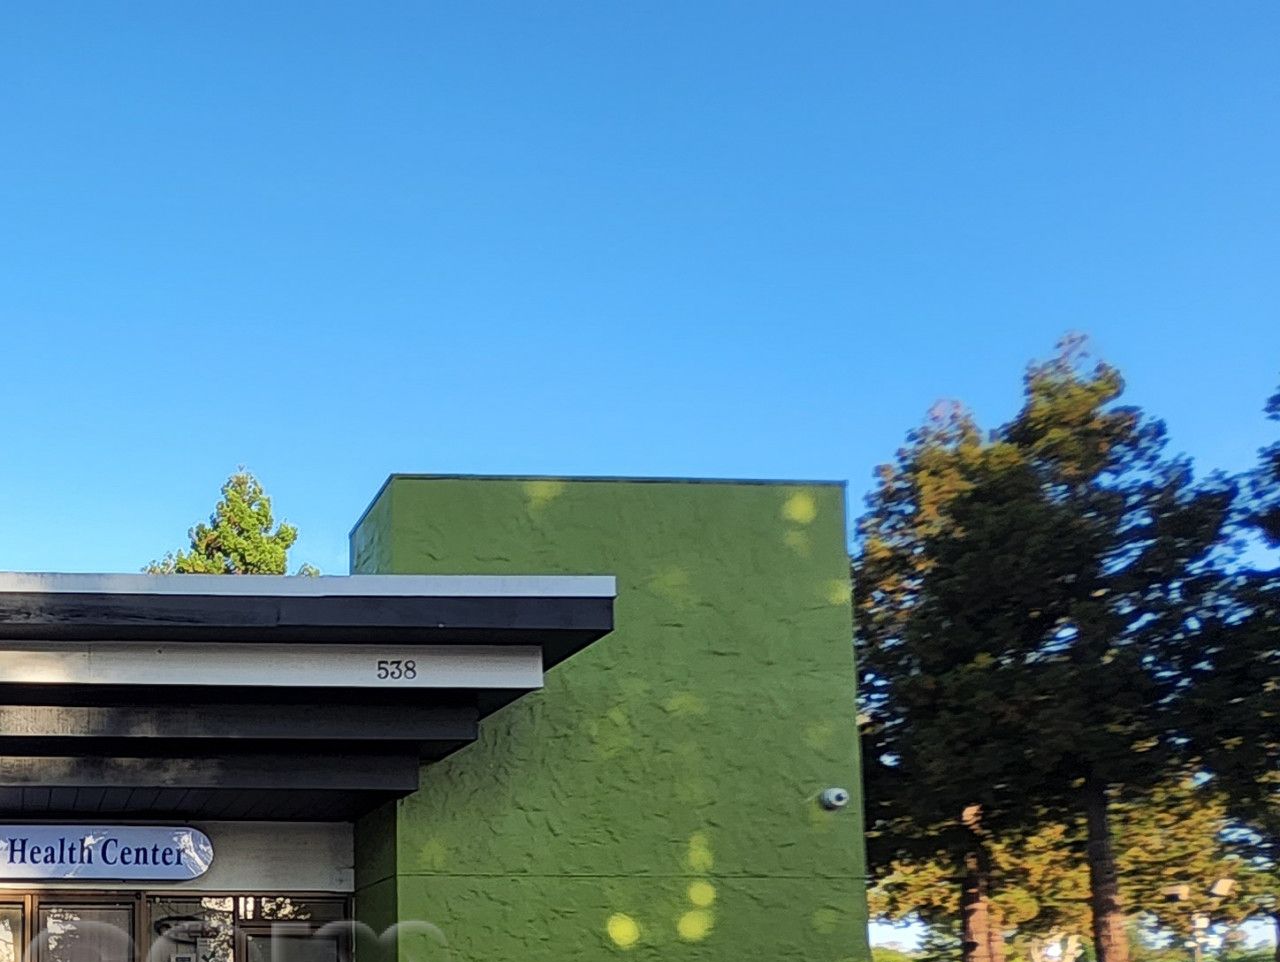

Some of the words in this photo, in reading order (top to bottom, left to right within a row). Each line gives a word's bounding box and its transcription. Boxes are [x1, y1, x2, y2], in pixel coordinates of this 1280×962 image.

[377, 660, 417, 679] 538
[7, 837, 94, 866] Health
[101, 838, 185, 867] Center
